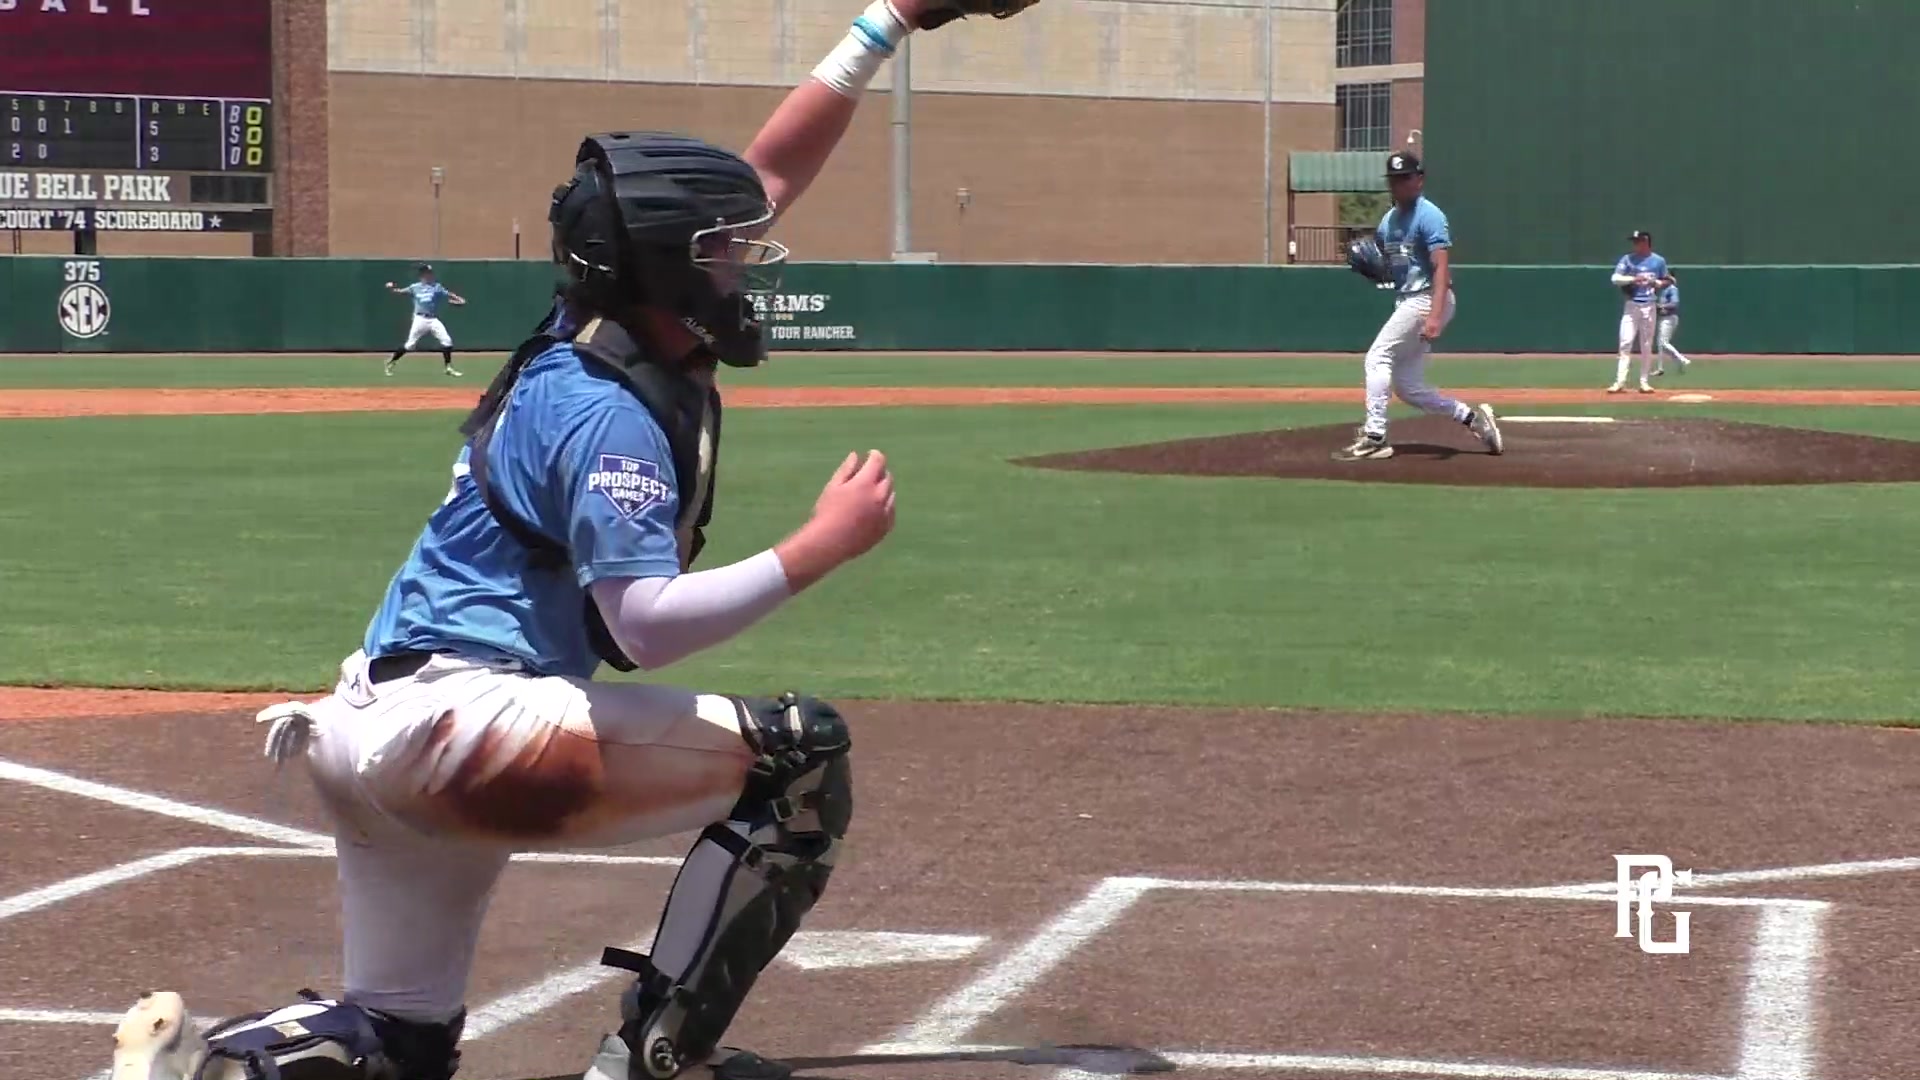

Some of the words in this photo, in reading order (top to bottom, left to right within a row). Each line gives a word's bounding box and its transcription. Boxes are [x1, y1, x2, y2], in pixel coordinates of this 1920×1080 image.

[11, 99, 19, 111] 5
[64, 100, 71, 112] 7
[152, 102, 160, 114] R
[203, 103, 210, 115] E
[229, 105, 241, 123] B
[11, 117, 20, 132] 0
[38, 118, 47, 133] 0
[64, 118, 72, 134] 1
[149, 121, 159, 136] 5
[229, 125, 241, 144] S
[12, 143, 21, 158] 2
[38, 144, 47, 159] 0
[150, 146, 160, 162] 3
[35, 173, 98, 200] BELL
[104, 175, 171, 201] PARK
[0, 210, 54, 229] COURT
[94, 211, 204, 230] SCOREBOARD
[64, 261, 100, 281] 375
[62, 286, 105, 334] SEC
[744, 294, 825, 312] ARMS
[771, 326, 800, 339] YOUR
[622, 460, 640, 471] TOP
[588, 471, 668, 501] PROSPECT
[612, 488, 645, 502] GAMES
